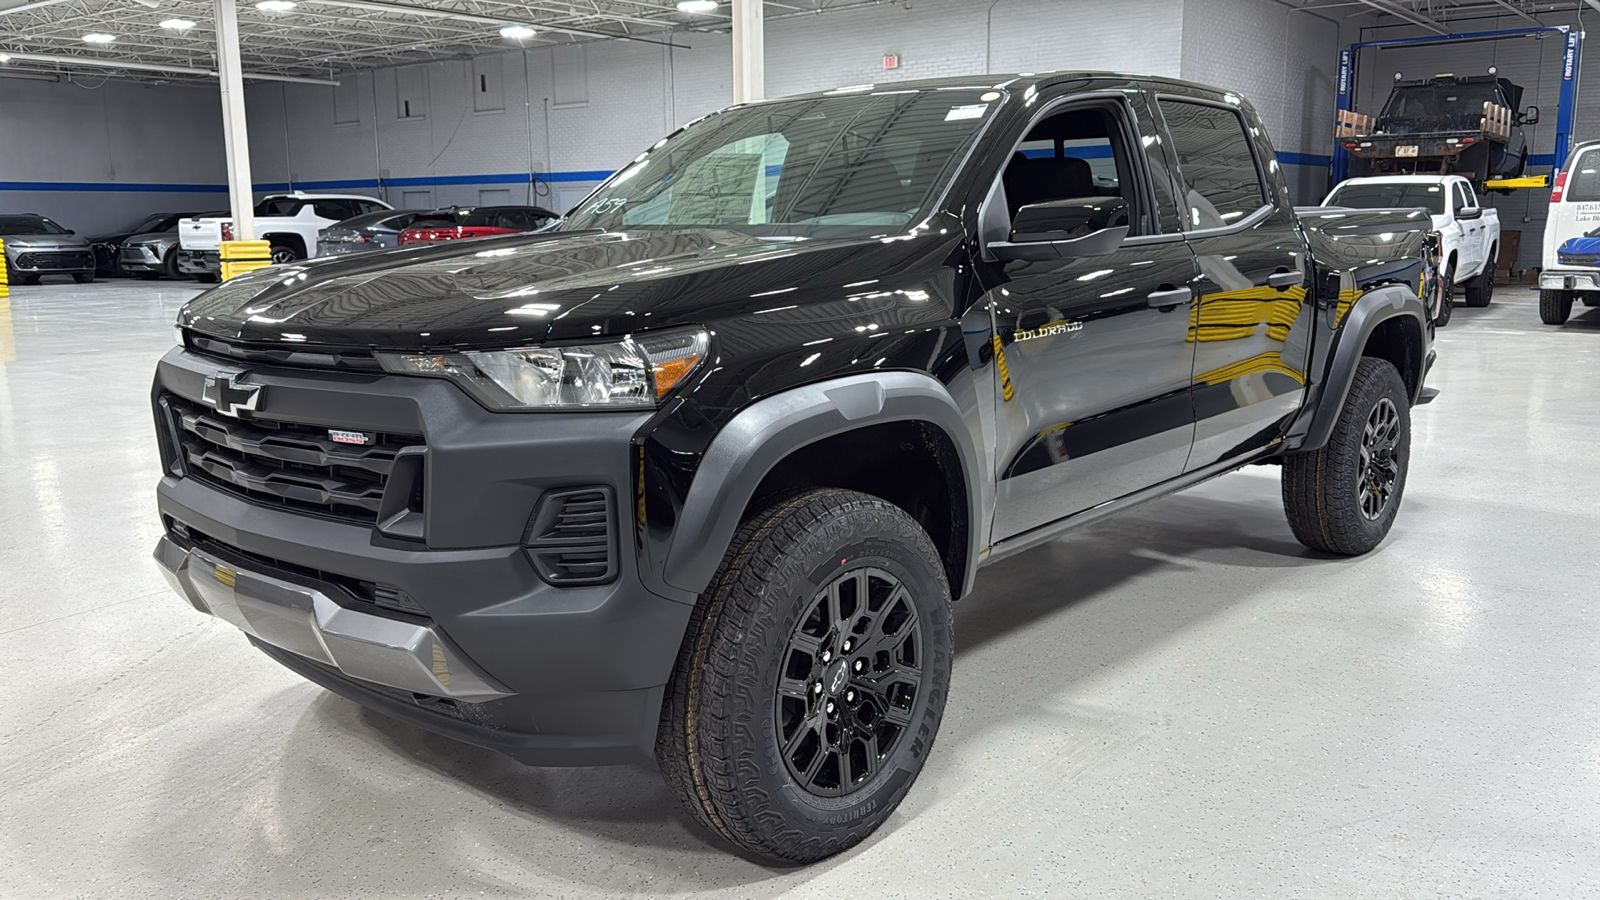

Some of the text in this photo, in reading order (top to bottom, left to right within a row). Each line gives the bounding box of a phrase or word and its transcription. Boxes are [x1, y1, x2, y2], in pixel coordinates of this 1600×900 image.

[1565, 32, 1576, 77] ROTARY LIFT
[1339, 65, 1348, 92] ROTARY
[582, 197, 628, 215] A59
[1013, 321, 1083, 342] COLORADO
[909, 608, 946, 759] WRANGLER
[822, 799, 878, 825] TERRITORY
